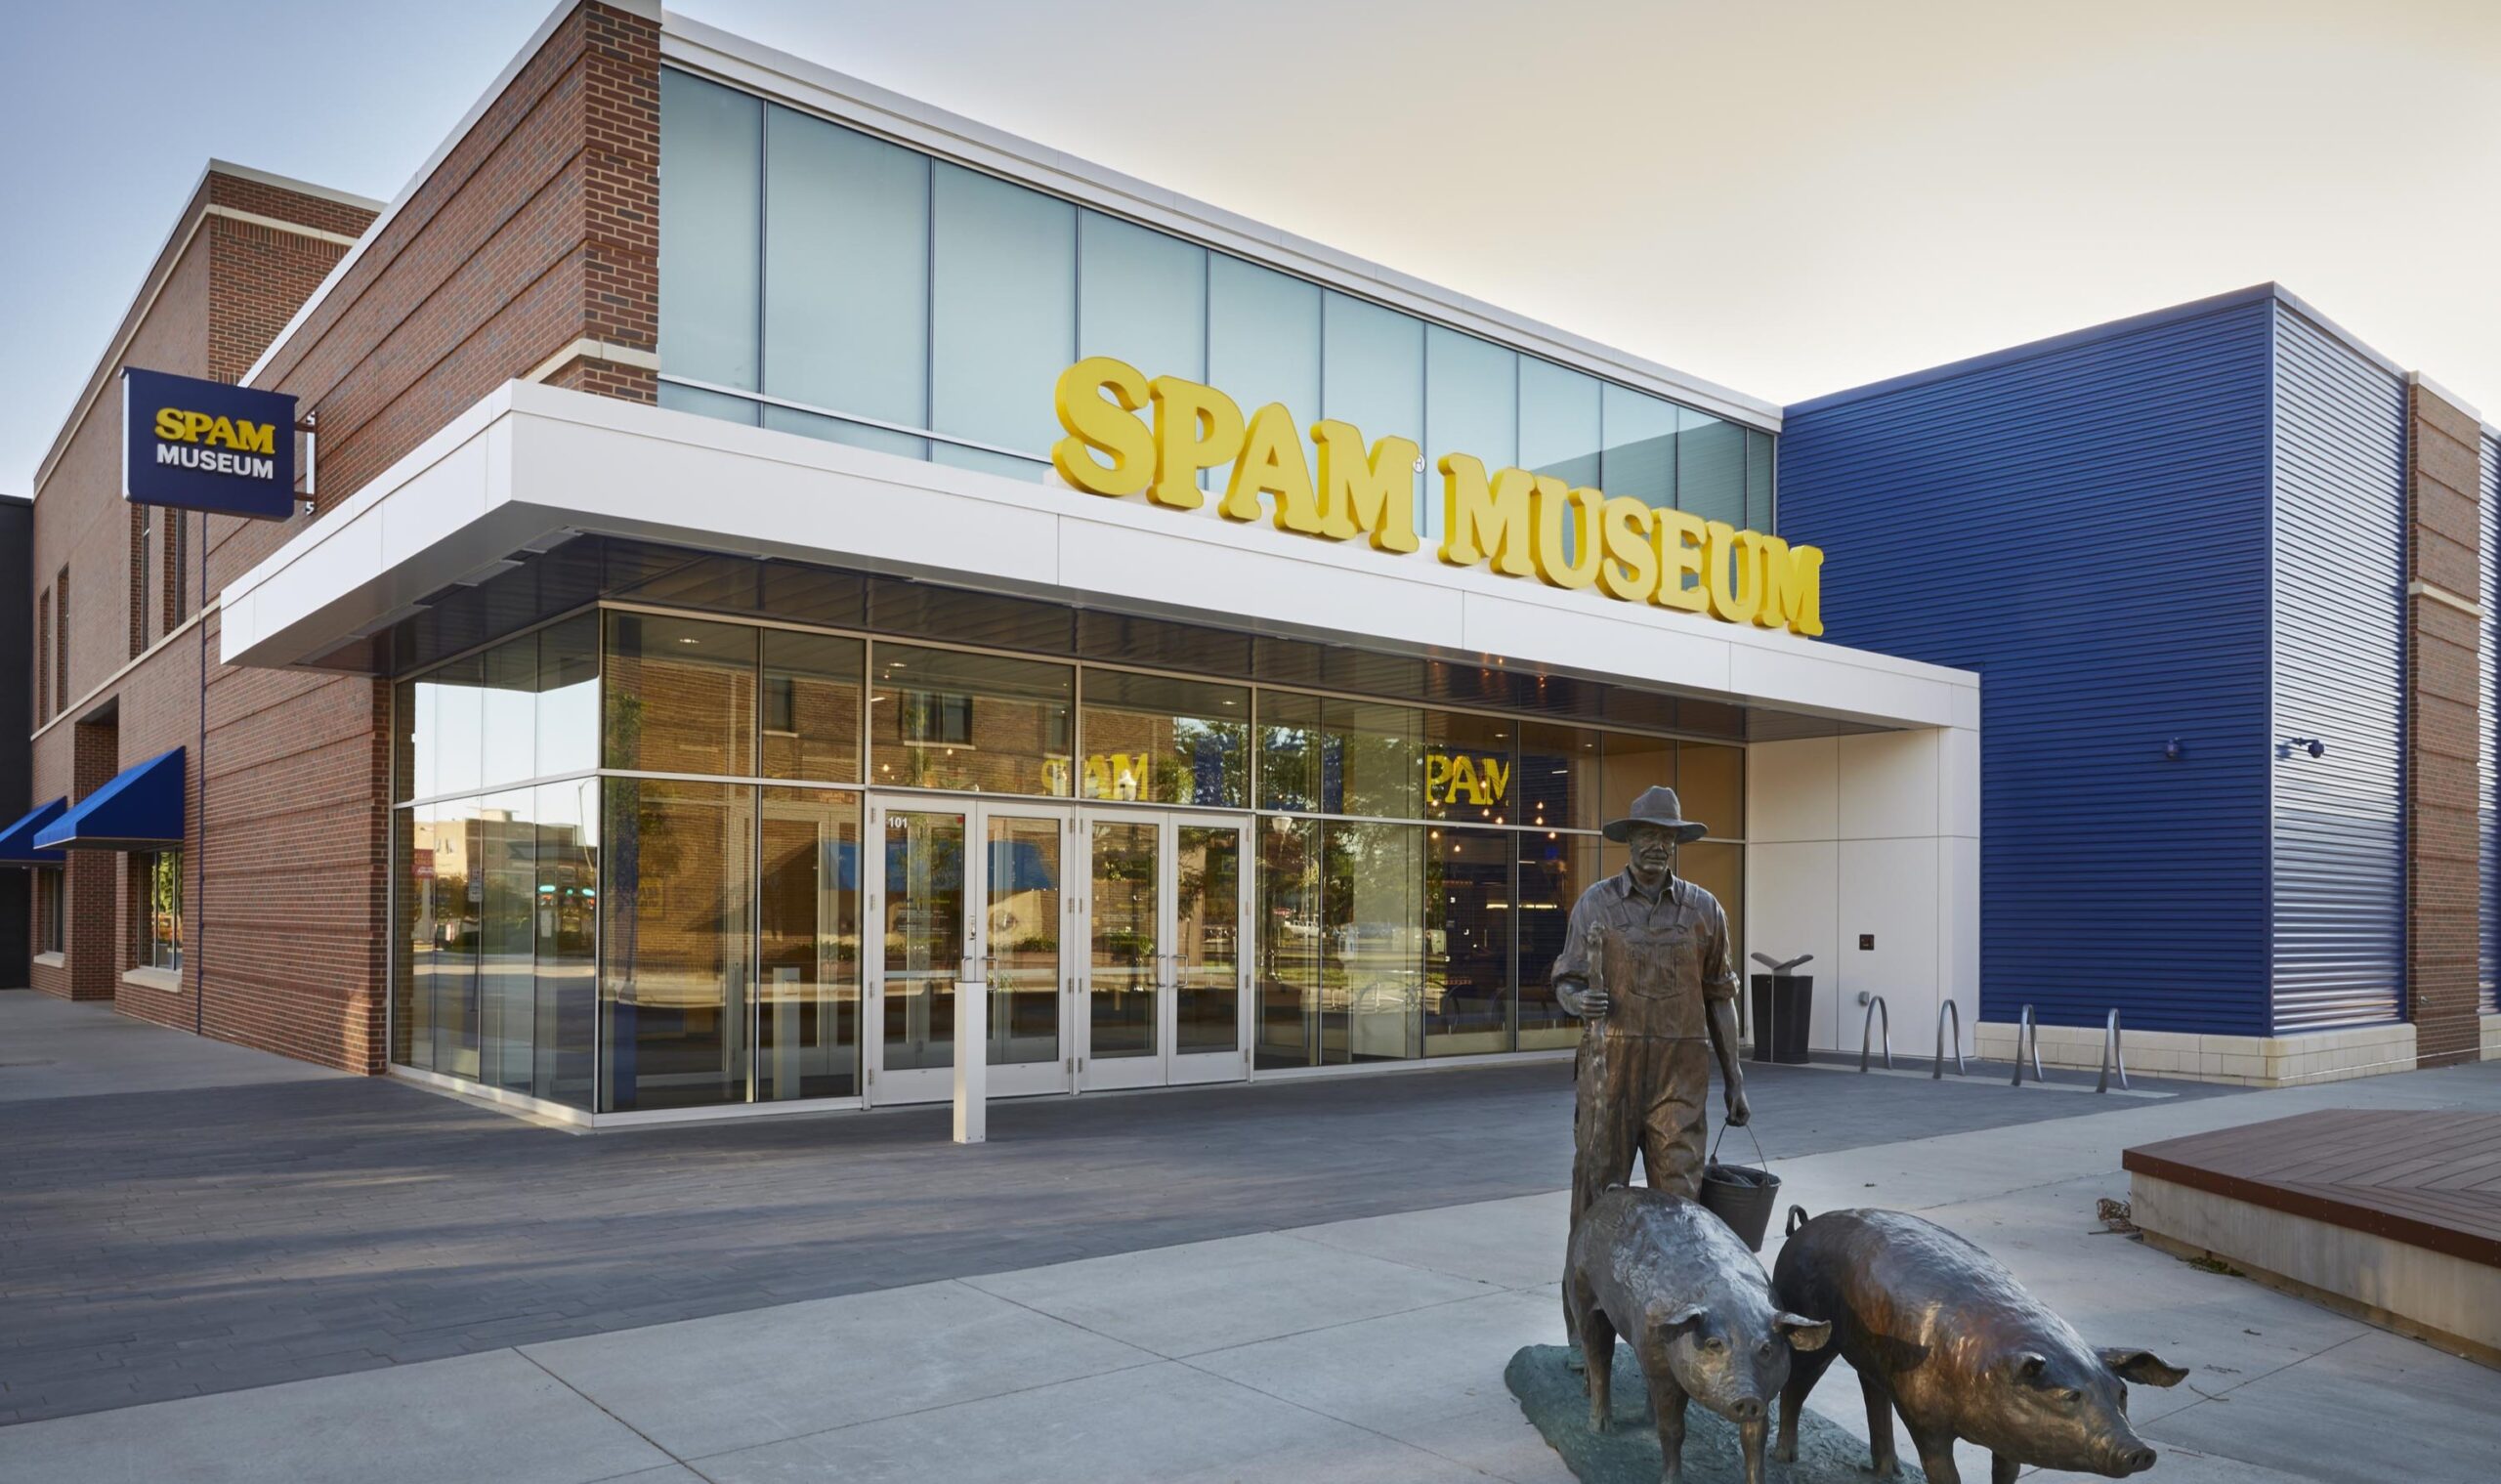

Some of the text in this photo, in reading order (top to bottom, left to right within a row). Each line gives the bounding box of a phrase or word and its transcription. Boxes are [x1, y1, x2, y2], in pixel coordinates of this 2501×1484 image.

[154, 407, 276, 454] SPAM
[156, 443, 274, 480] MUSEUM
[1437, 452, 1824, 637] MUSEUM
[888, 816, 908, 829] 101
